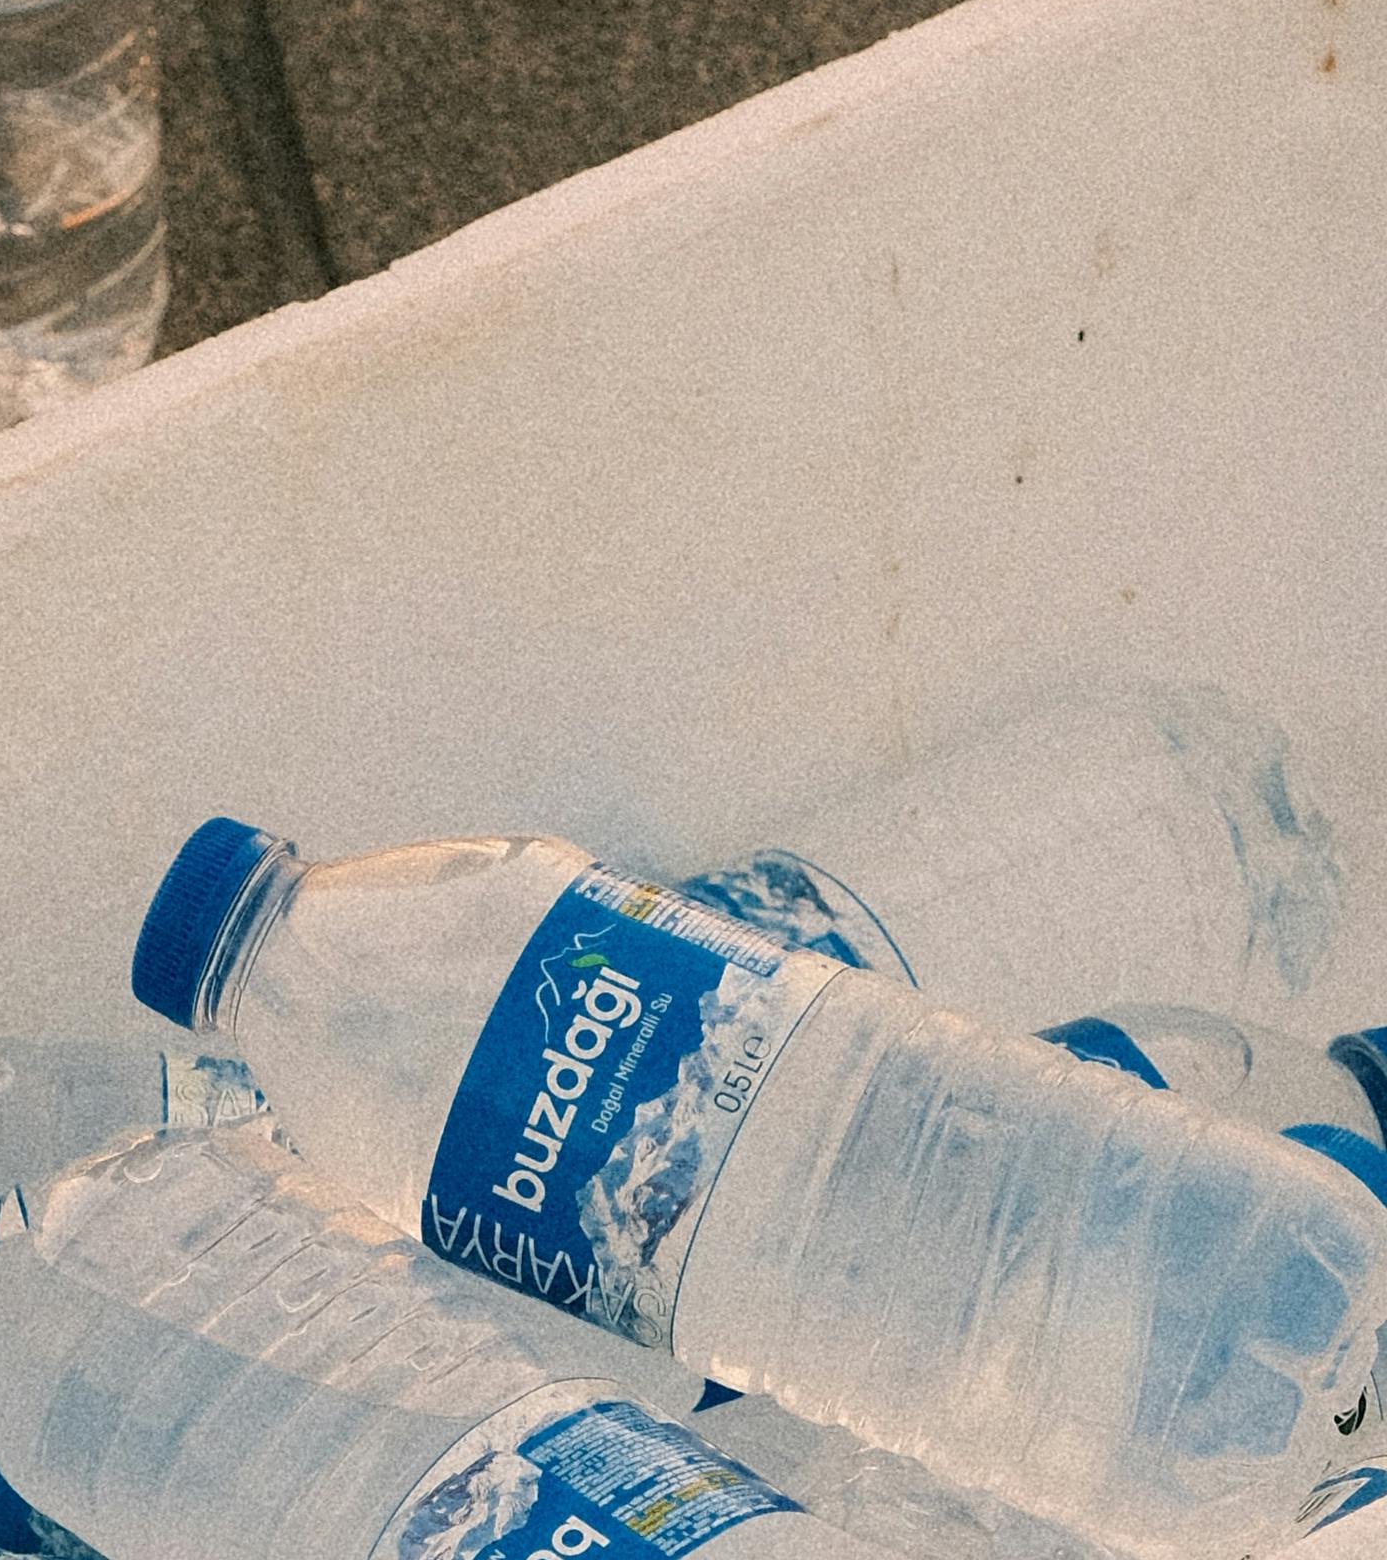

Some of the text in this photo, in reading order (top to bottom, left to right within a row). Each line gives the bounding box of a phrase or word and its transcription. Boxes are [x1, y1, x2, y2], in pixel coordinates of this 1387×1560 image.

[492, 966, 642, 1212] buzdağı
[591, 991, 673, 1134] Doğal Mineralli Su
[431, 1193, 667, 1349] SAKARYA
